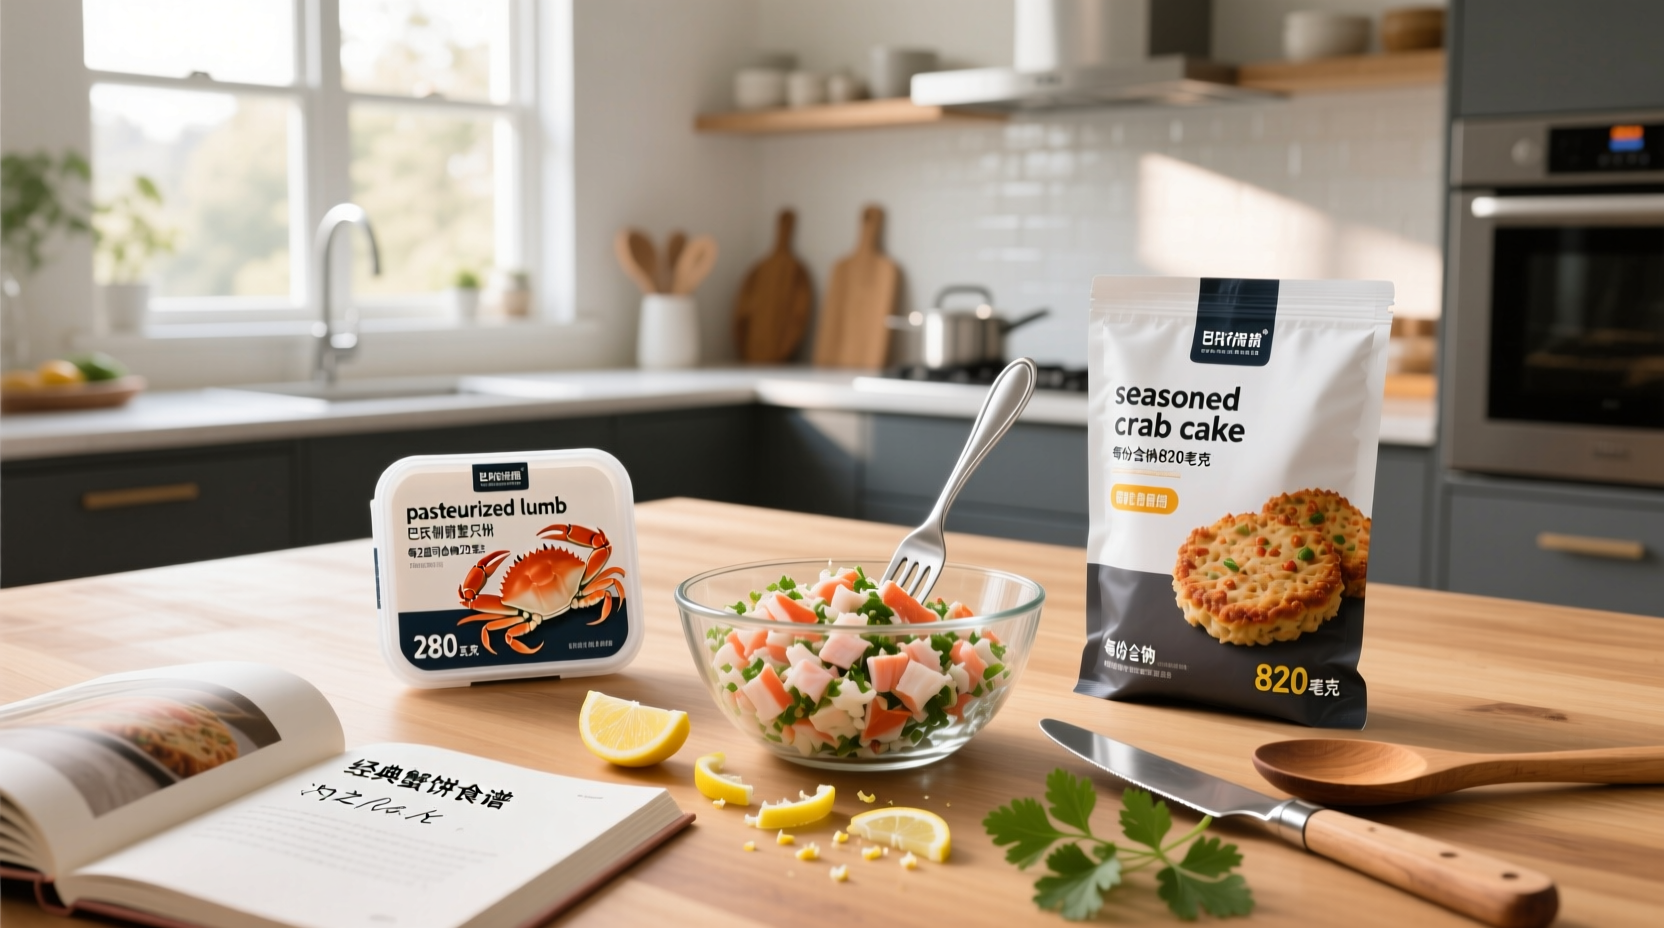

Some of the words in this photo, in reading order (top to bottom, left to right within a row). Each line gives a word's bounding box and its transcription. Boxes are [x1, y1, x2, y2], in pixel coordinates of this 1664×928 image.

[1115, 385, 1241, 411] seasoned
[1115, 412, 1171, 439] crab
[1180, 415, 1246, 443] cake
[407, 498, 515, 524] pasteurized
[521, 496, 567, 515] lumb
